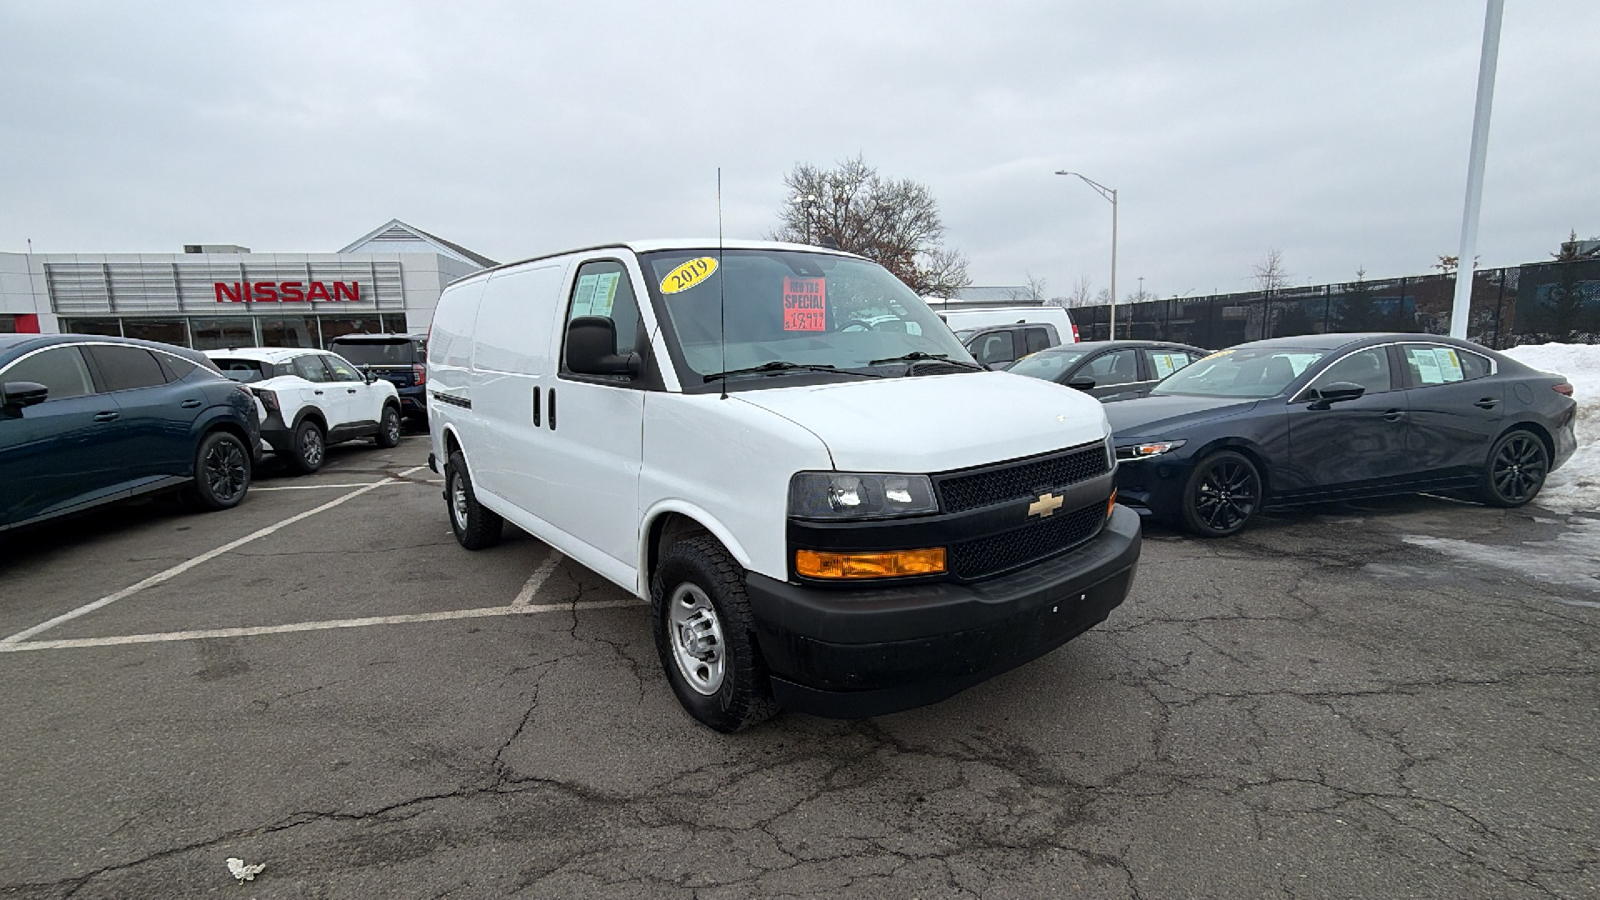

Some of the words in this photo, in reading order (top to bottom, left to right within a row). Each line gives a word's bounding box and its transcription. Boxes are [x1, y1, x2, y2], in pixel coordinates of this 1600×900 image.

[671, 260, 708, 289] 2019
[214, 281, 360, 303] NISSAN
[785, 294, 824, 309] SPECIAL
